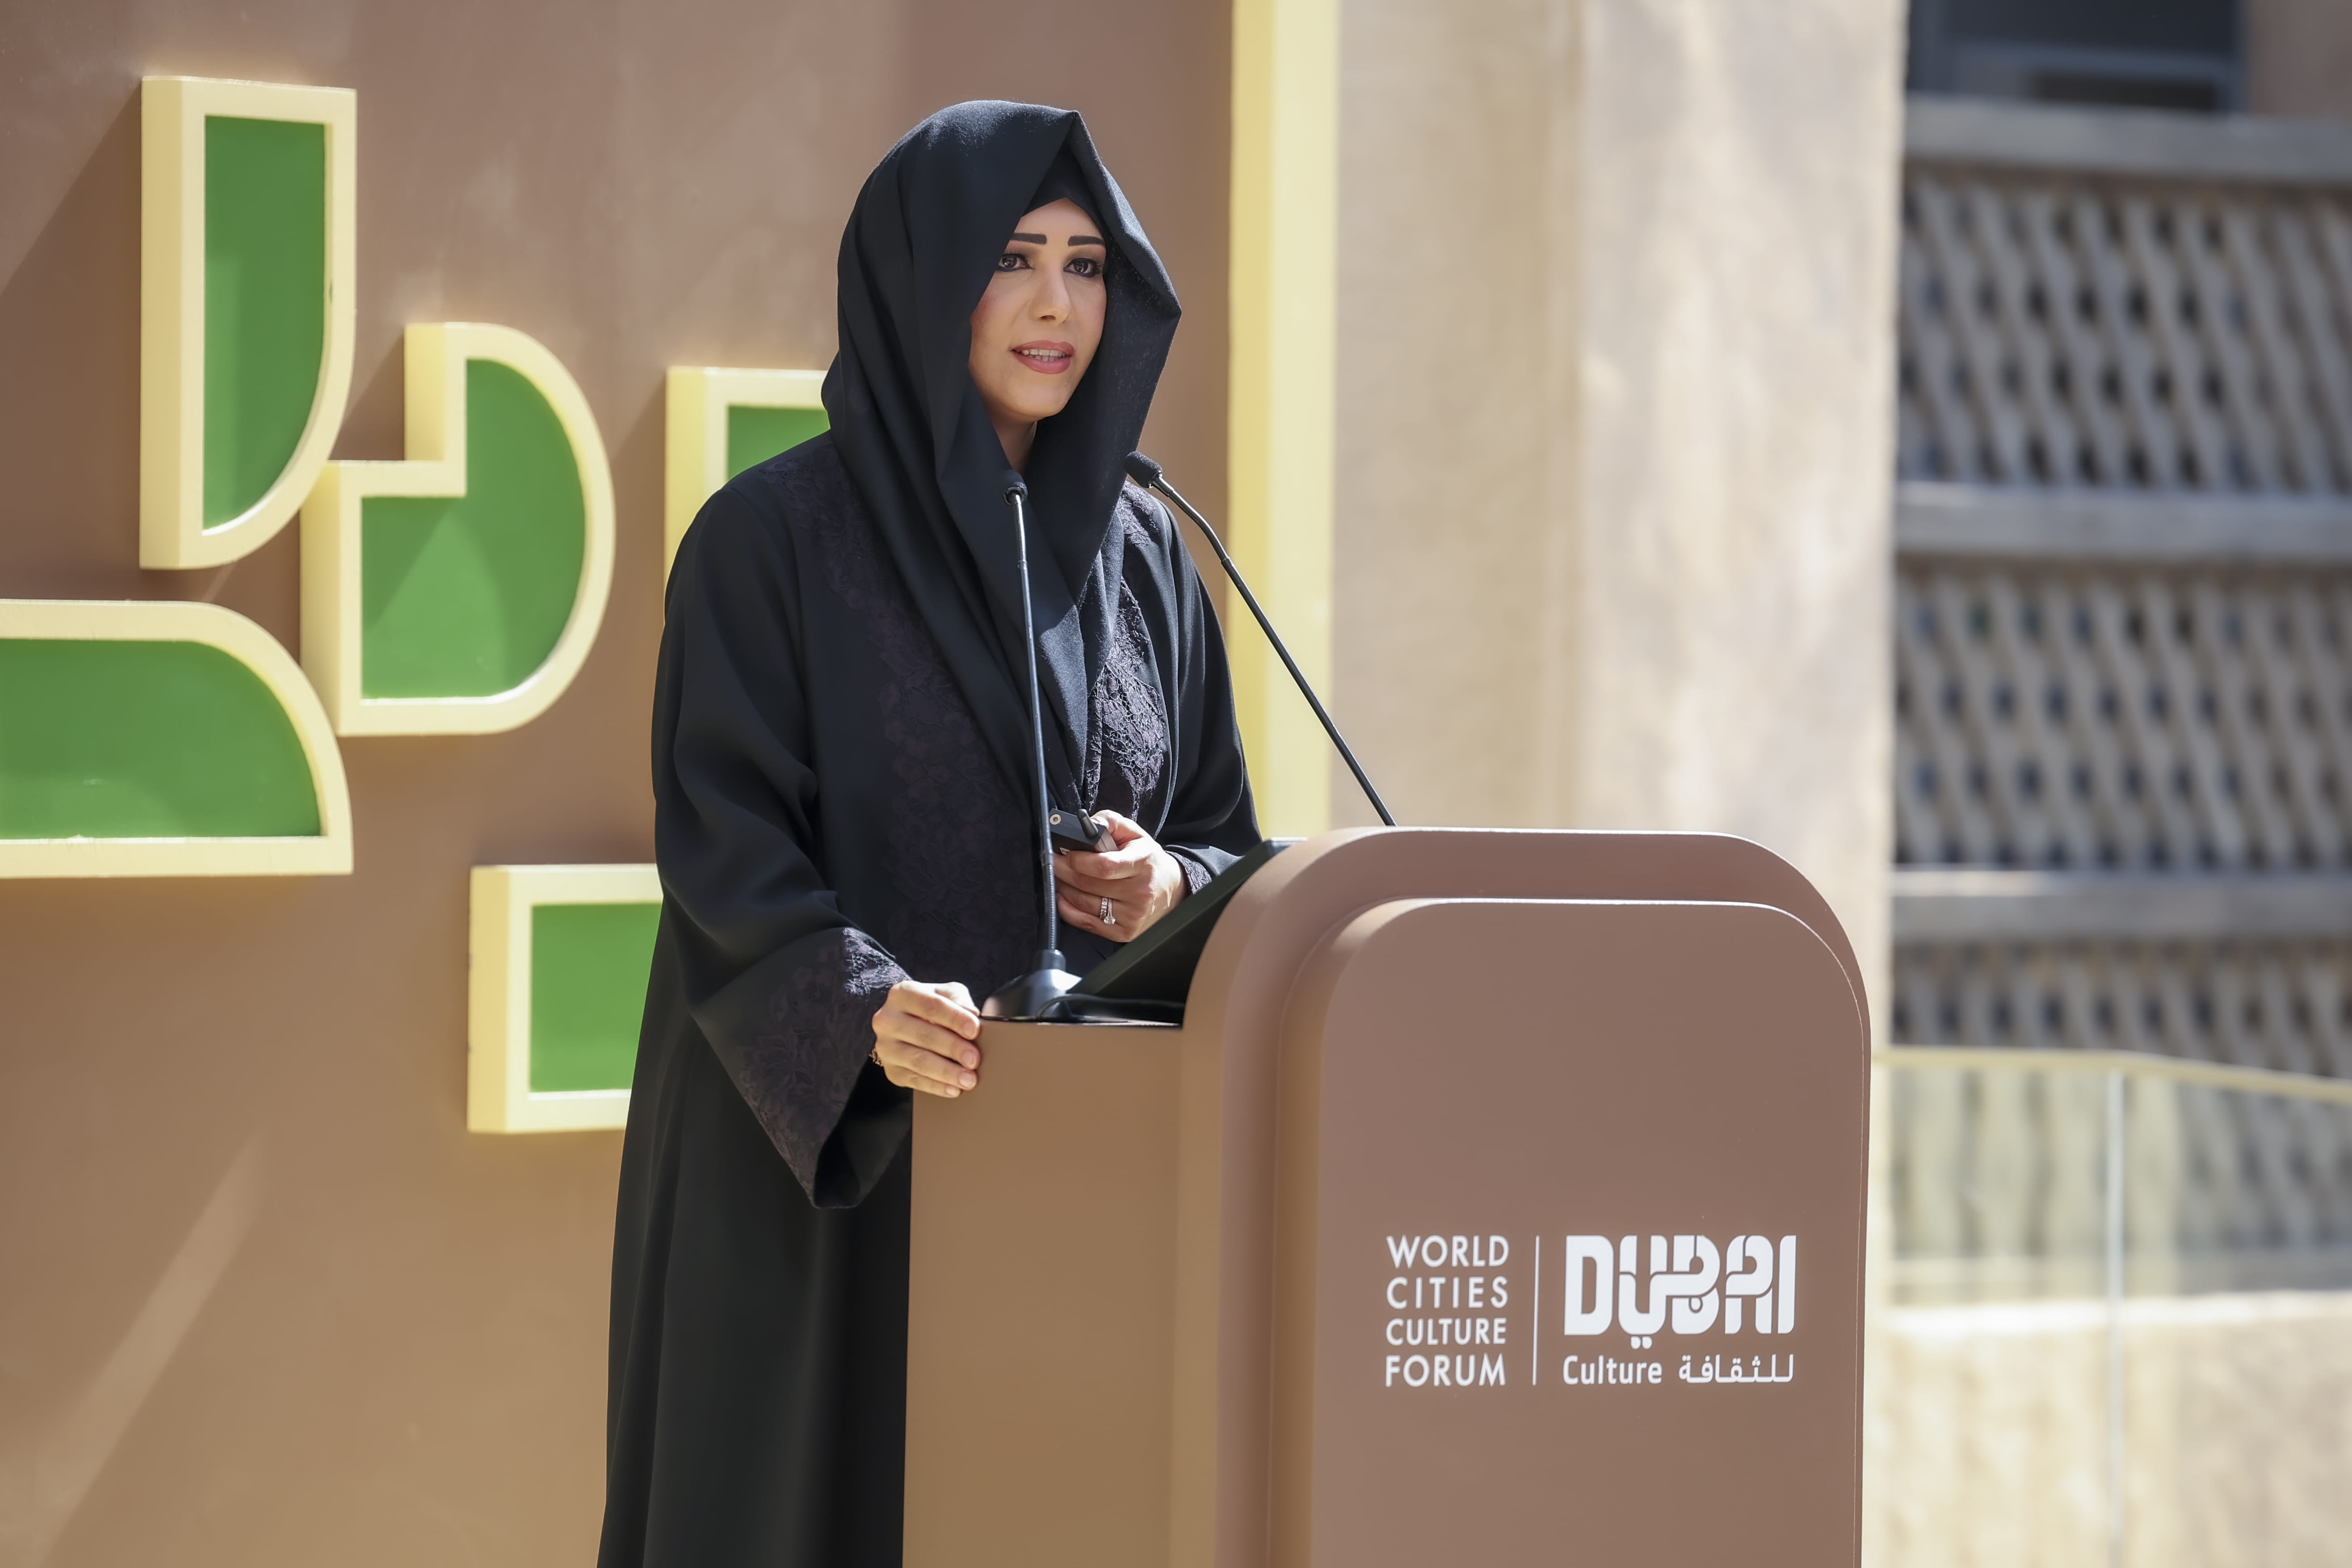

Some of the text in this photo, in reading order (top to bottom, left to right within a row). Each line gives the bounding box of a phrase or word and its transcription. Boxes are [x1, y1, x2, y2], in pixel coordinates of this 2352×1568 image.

[1386, 1235, 1510, 1268] WORLD
[1386, 1276, 1509, 1309] CITIES
[1385, 1318, 1507, 1346] CULTURE
[1385, 1354, 1506, 1387] FORUM
[1562, 1355, 1663, 1385] Culture
[1678, 1354, 1794, 1383] للثقافة
